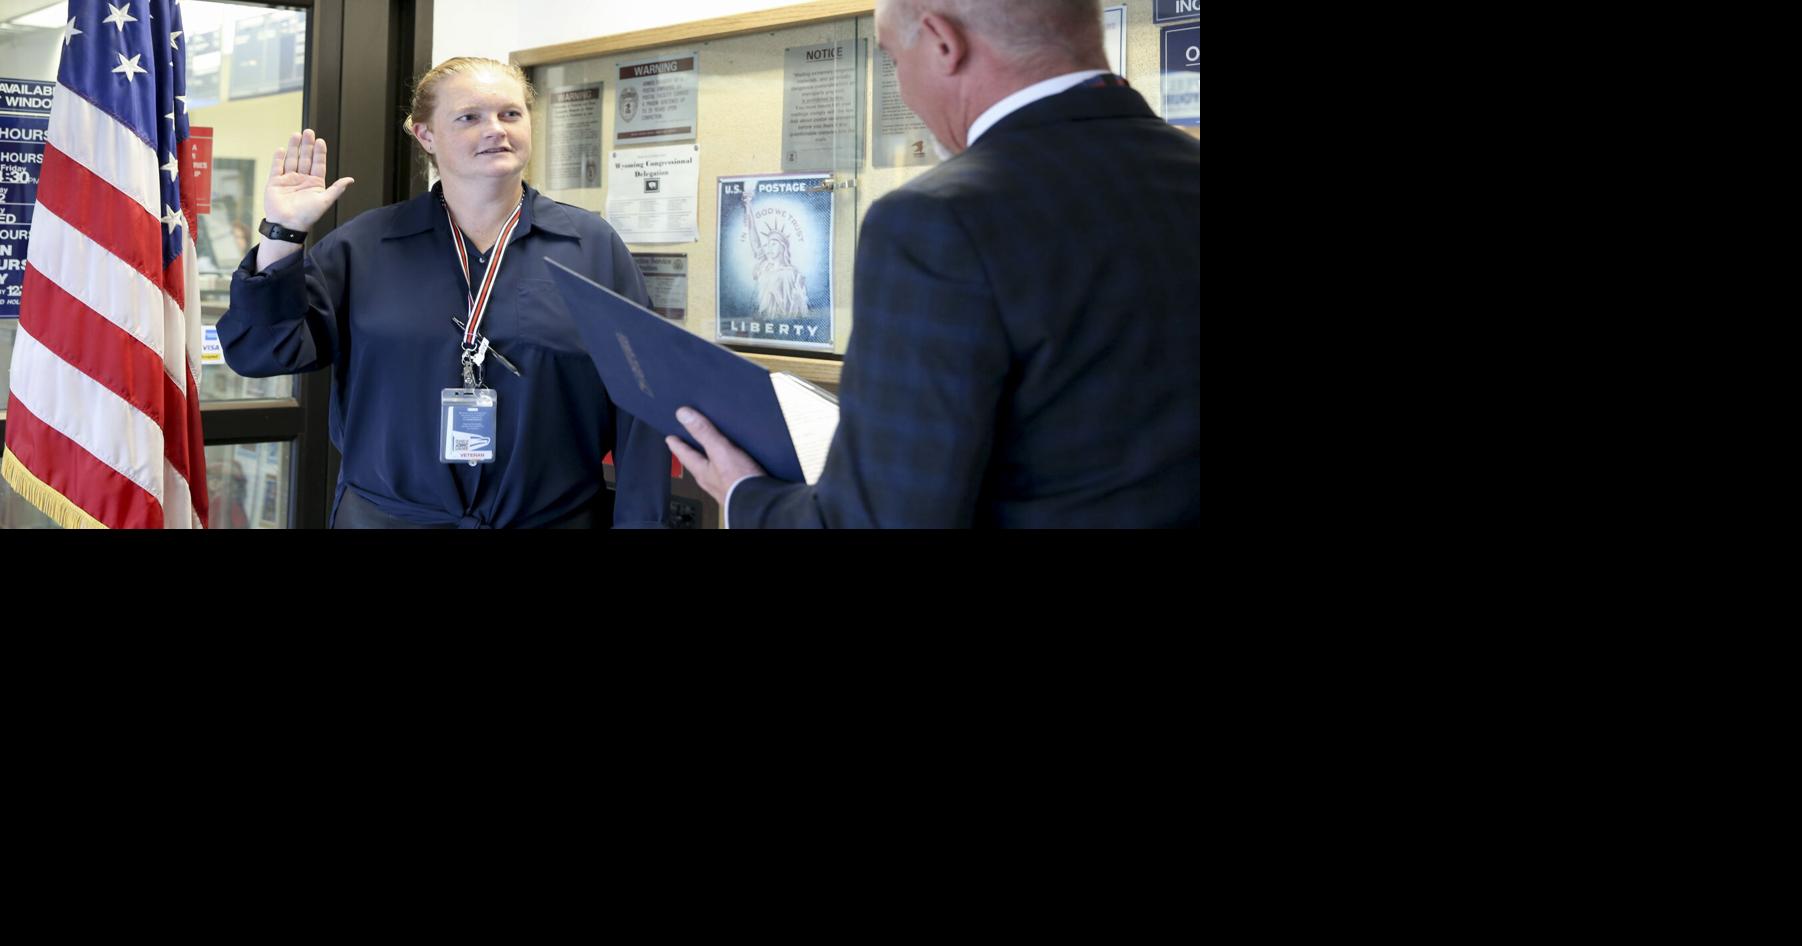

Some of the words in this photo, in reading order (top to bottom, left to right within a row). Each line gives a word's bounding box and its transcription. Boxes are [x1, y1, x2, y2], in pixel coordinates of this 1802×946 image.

[806, 47, 843, 60] NOTICE
[634, 61, 677, 76] WARNING
[558, 90, 592, 102] WARNING
[1, 152, 43, 163] HOURS
[1, 164, 26, 172] Friday
[725, 184, 742, 194] U.S.
[759, 182, 806, 193] POSTAGE
[755, 207, 774, 219] GOD
[775, 207, 787, 217] WE
[788, 213, 805, 242] TRUST
[731, 320, 818, 337] LIBERTY
